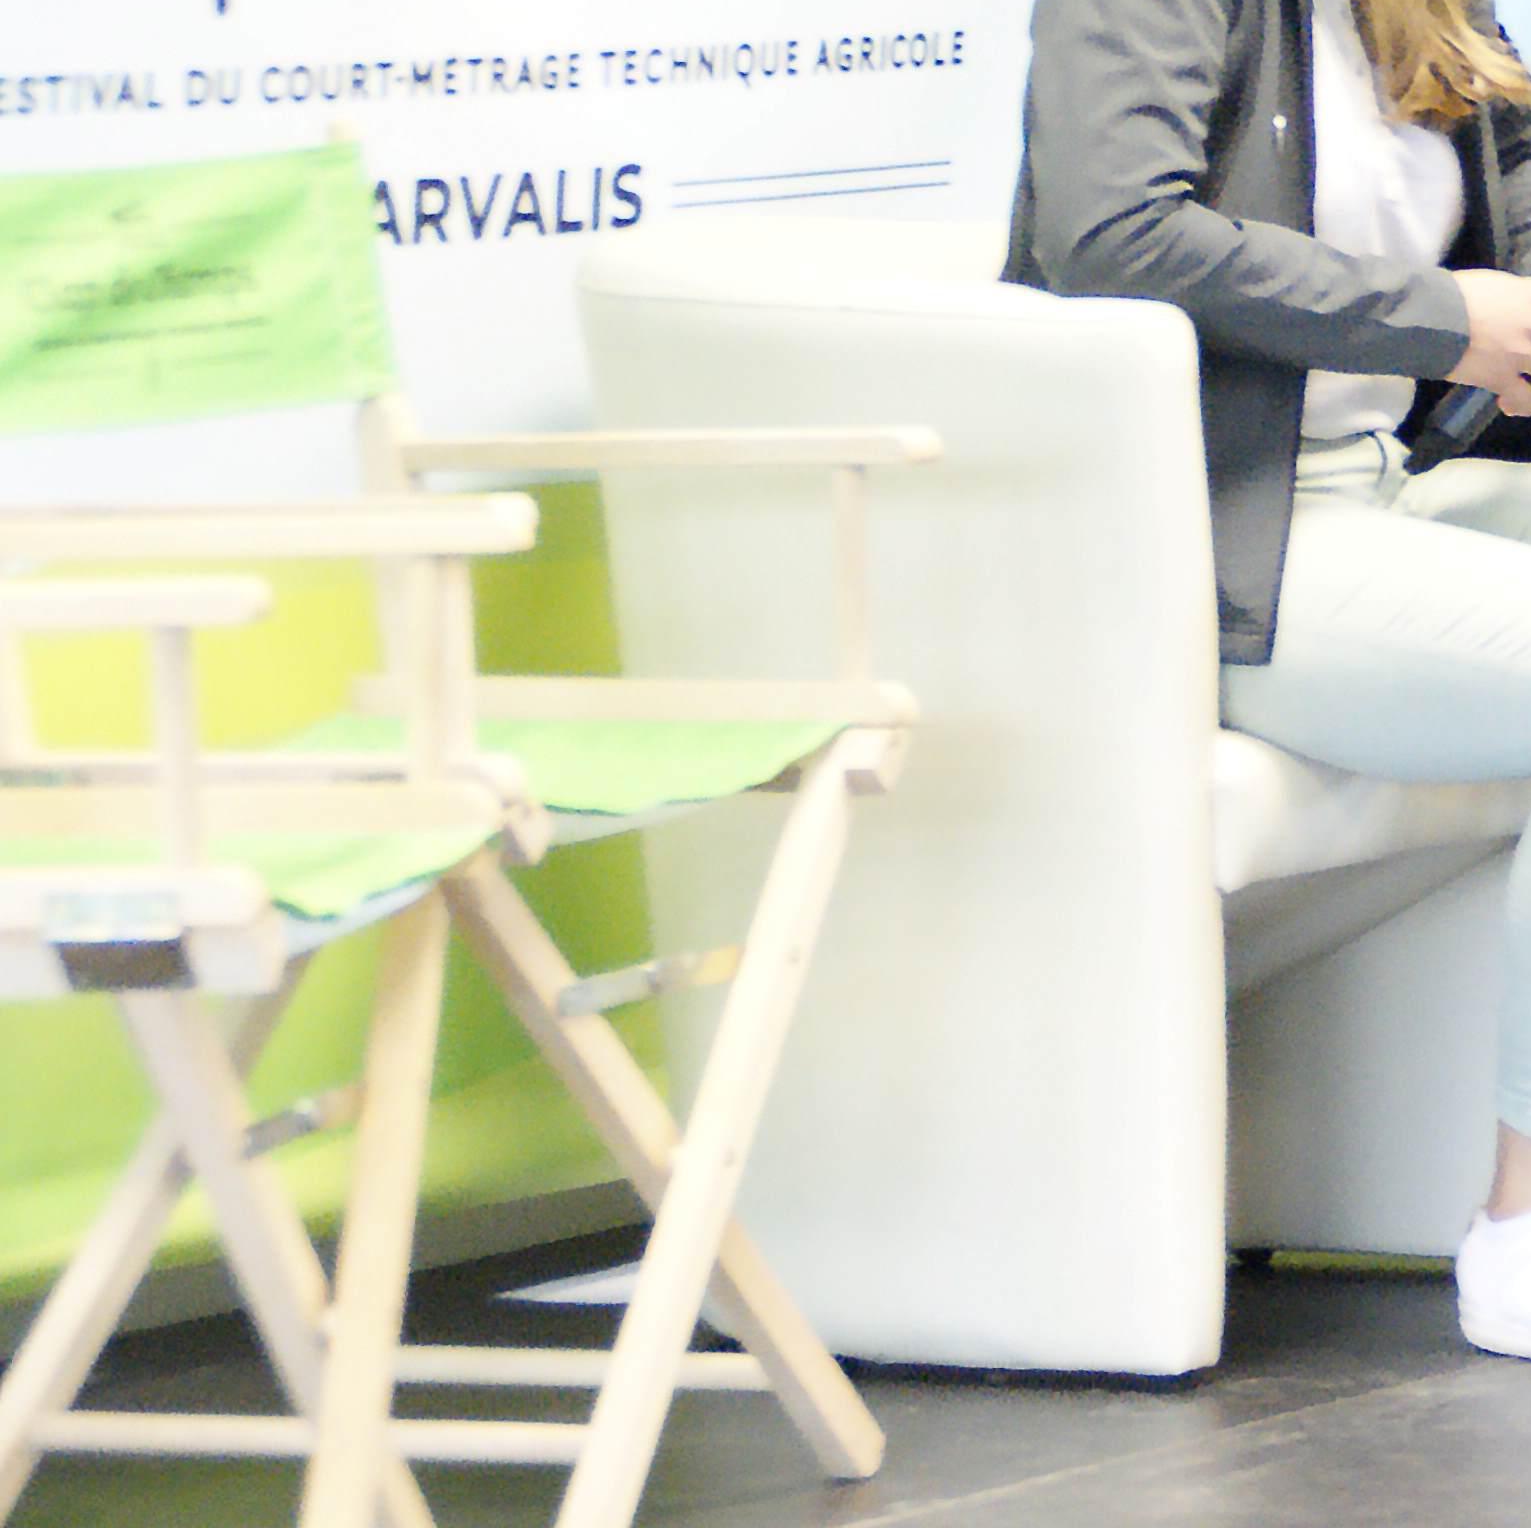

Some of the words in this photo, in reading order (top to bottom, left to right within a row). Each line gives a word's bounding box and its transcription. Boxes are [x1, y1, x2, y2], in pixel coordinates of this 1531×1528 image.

[184, 69, 241, 108] DU
[599, 40, 799, 90] TECHNIQUE
[814, 29, 966, 76] AGRICOLE
[374, 163, 643, 246] ARVALIS
